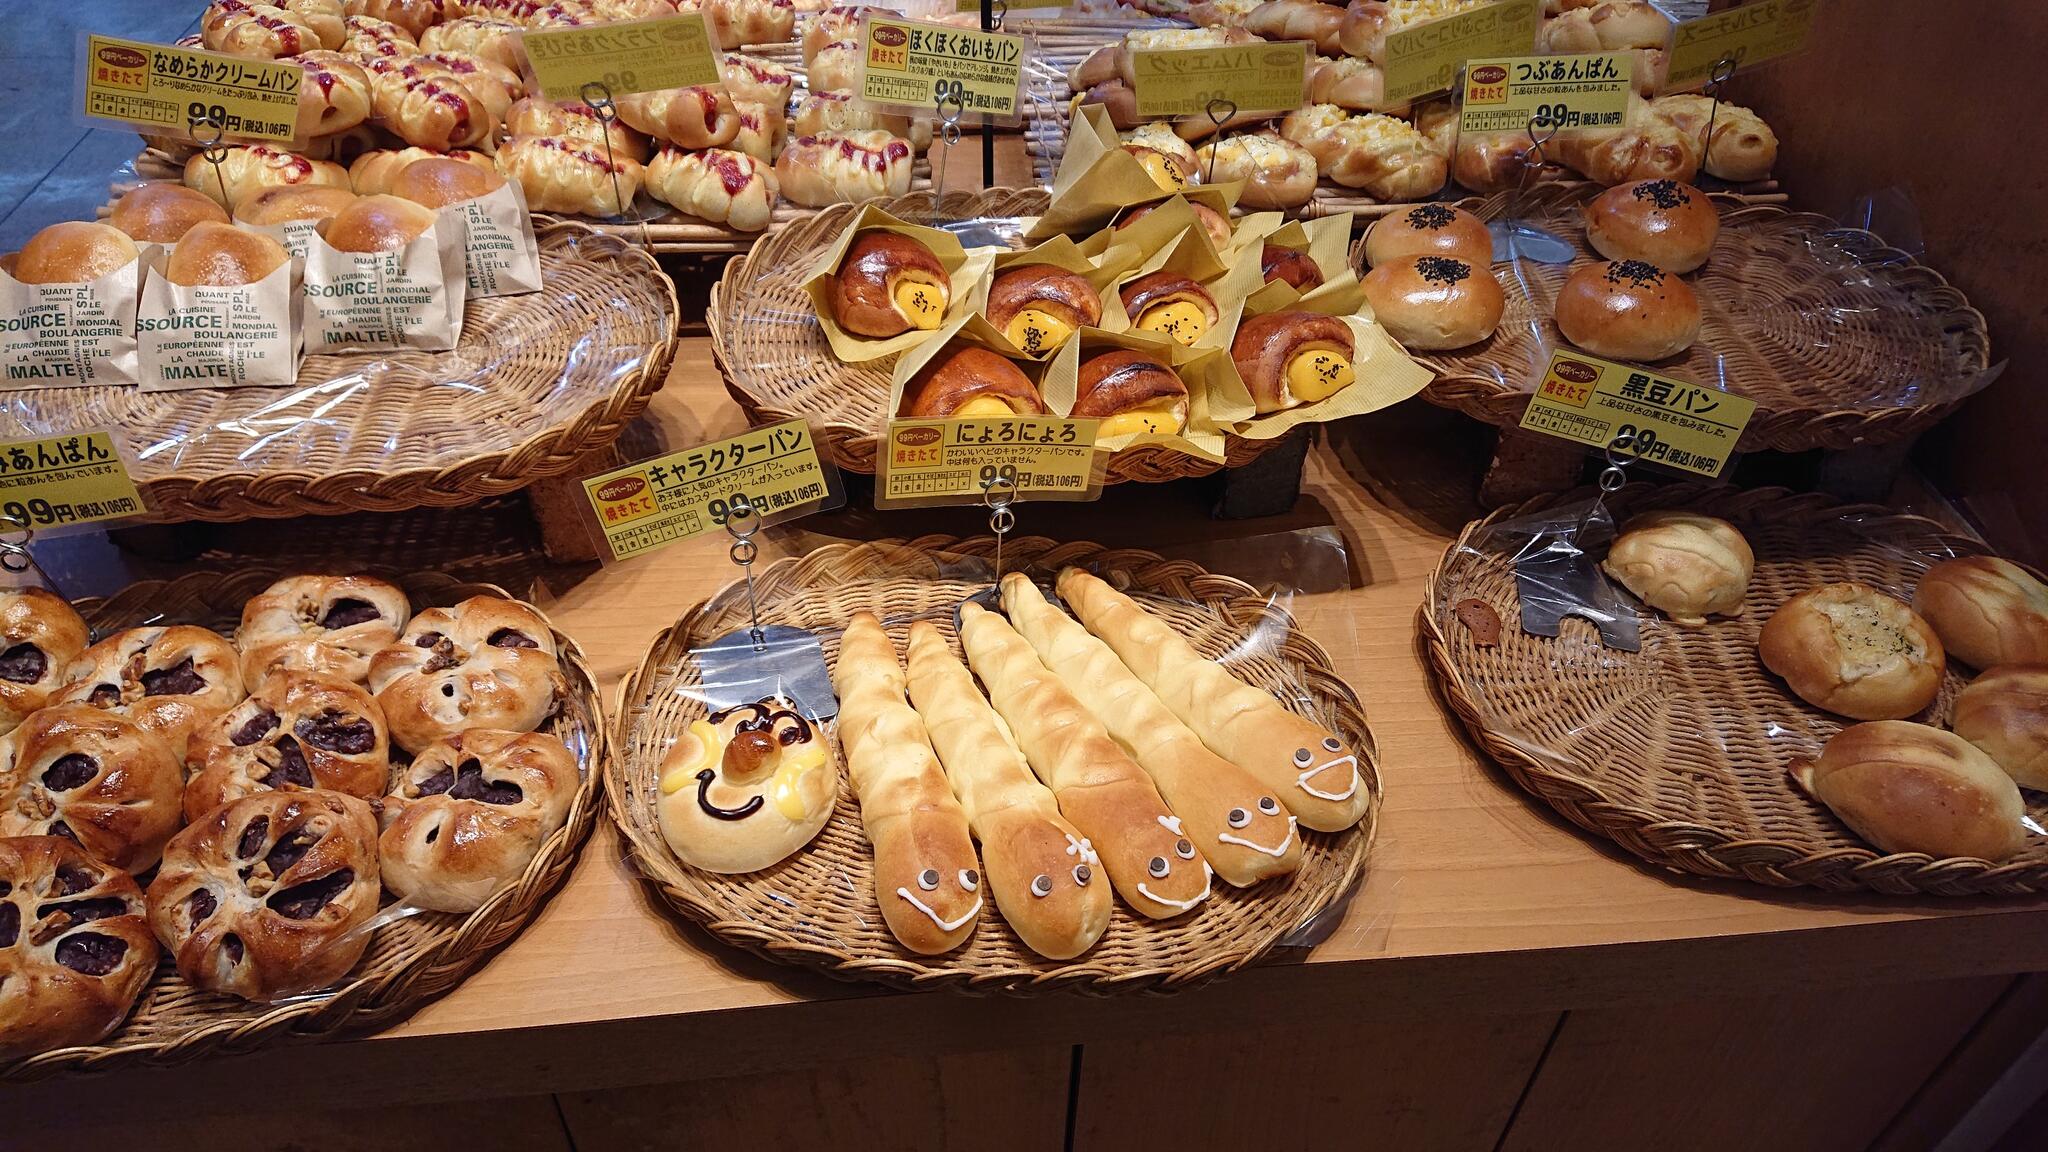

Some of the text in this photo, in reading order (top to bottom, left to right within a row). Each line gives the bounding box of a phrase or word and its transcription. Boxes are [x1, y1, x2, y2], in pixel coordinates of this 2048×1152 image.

[910, 30, 1019, 62] ほくほくおいもパン
[101, 50, 145, 64] 99円ベーカリー
[872, 47, 903, 64] 焼きたて
[154, 52, 299, 91] なめらかクリームパン
[1517, 57, 1618, 81] つぶあんぱん
[97, 68, 143, 86] 焼きたて
[1470, 87, 1503, 100] 焼きたて
[468, 201, 479, 224] SPL
[386, 252, 395, 275] SPL
[332, 272, 373, 283] LA CUISINE
[397, 268, 407, 276] LE
[485, 261, 497, 289] ROCHE
[40, 288, 73, 296] QUANT
[77, 285, 88, 308] SPL
[386, 286, 431, 294] MONDIAL
[233, 289, 244, 312] SPL
[353, 296, 432, 305] BOULANGERIE
[19, 304, 59, 316] LA CUISINE
[179, 306, 216, 314] CUISINE
[326, 306, 382, 315] EUROPÉENNE
[76, 319, 122, 327] MONDIAL
[232, 322, 277, 330] MONDIAL
[332, 321, 344, 329] LA
[40, 328, 123, 338] BOULANGERIE
[194, 331, 278, 339] BOULANGERIE
[327, 330, 389, 344] MALTE
[11, 339, 69, 349] EUROPÉENNE
[163, 340, 224, 349] EUROPÉENNE
[32, 348, 70, 357] CHAUDE
[171, 355, 183, 363] LA
[10, 363, 77, 379] MALTE
[83, 348, 95, 379] ROCHE
[237, 350, 246, 380] ROCHE
[164, 364, 228, 380] MALTE
[1556, 363, 1597, 380] 99円ベーカリー
[1544, 380, 1589, 402] 焼きたて
[1620, 372, 1719, 413] 黒豆パン
[1596, 397, 1727, 439] 上品な甘さの黒豆を包みました。
[899, 432, 940, 443] 99円ベーカリー
[957, 422, 1077, 443] にょろにょろ
[649, 430, 802, 487] キャラクターパン
[896, 448, 938, 463] 焼きたて
[946, 447, 1086, 458] かわいいヘビのキャラクターパンです。
[946, 456, 1037, 467] 中は何も入っていません。
[658, 462, 783, 503] お子様に人気のキャラクターパン。
[661, 463, 818, 512] 中にはカスタードクリームが入っています。
[598, 481, 644, 500] 99円ベーカリー
[605, 497, 652, 522] 焼きたて
